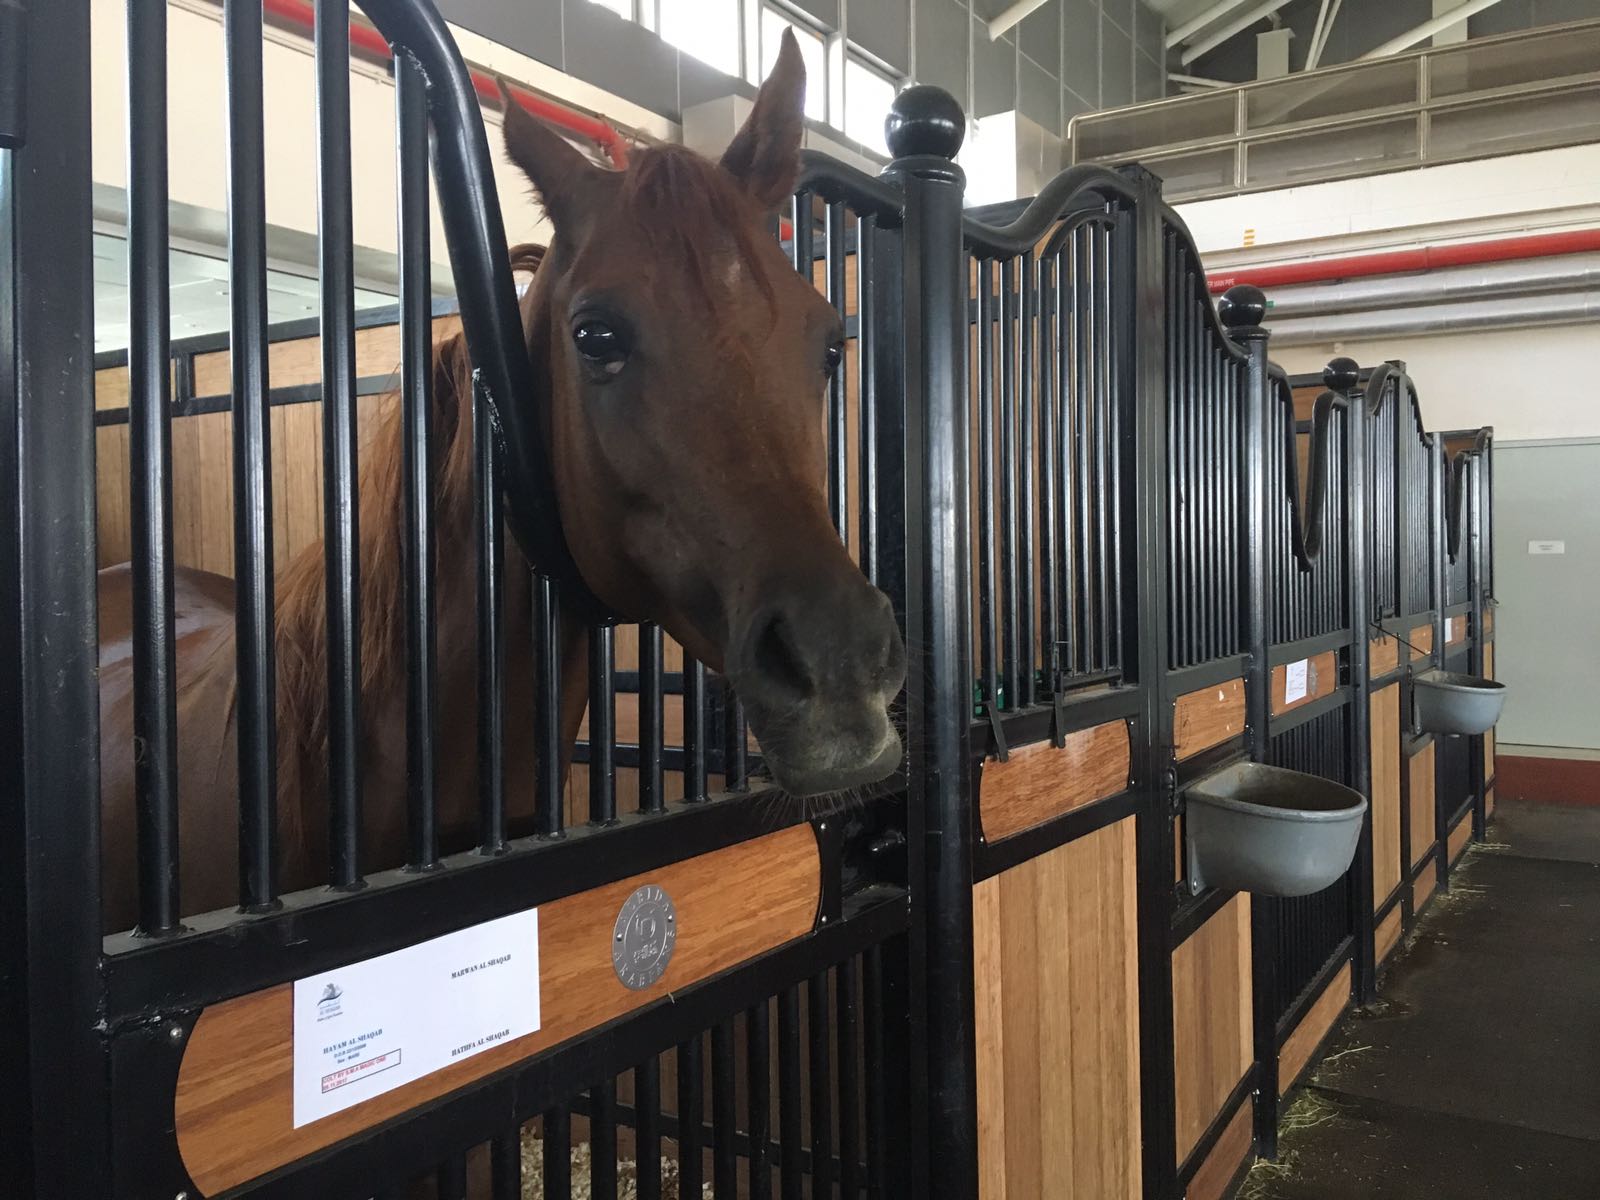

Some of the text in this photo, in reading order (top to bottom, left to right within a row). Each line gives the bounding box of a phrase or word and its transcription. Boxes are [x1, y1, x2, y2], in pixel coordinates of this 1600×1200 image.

[451, 954, 511, 979] MARWAN AL SHAQAB
[323, 1029, 383, 1055] HAYAM AL SHAQAB
[451, 1029, 510, 1057] HATHFA AL SHAQAB
